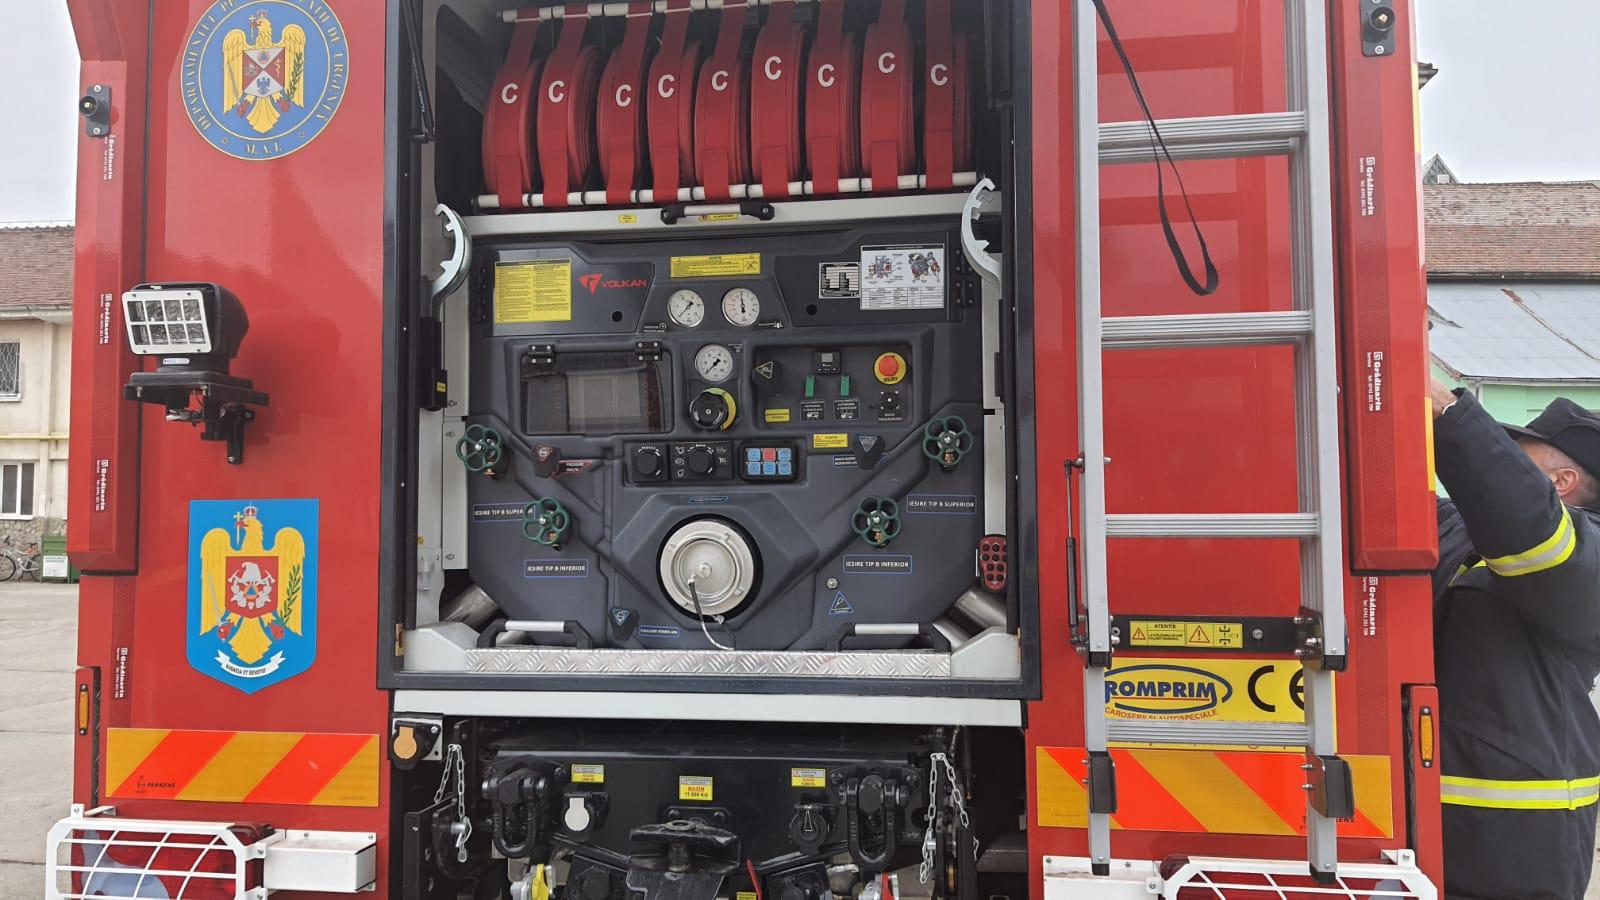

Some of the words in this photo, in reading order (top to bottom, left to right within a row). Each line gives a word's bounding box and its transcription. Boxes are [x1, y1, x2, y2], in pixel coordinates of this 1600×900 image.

[764, 56, 782, 80] C
[878, 52, 896, 73] C
[657, 74, 675, 98] C
[711, 70, 729, 91] C
[817, 64, 835, 87] C
[930, 64, 948, 86] C
[501, 83, 519, 104] C
[548, 80, 565, 103] C
[615, 84, 632, 107] C
[601, 279, 647, 288] VOLKAN
[1104, 681, 1217, 704] ROMPRIM
